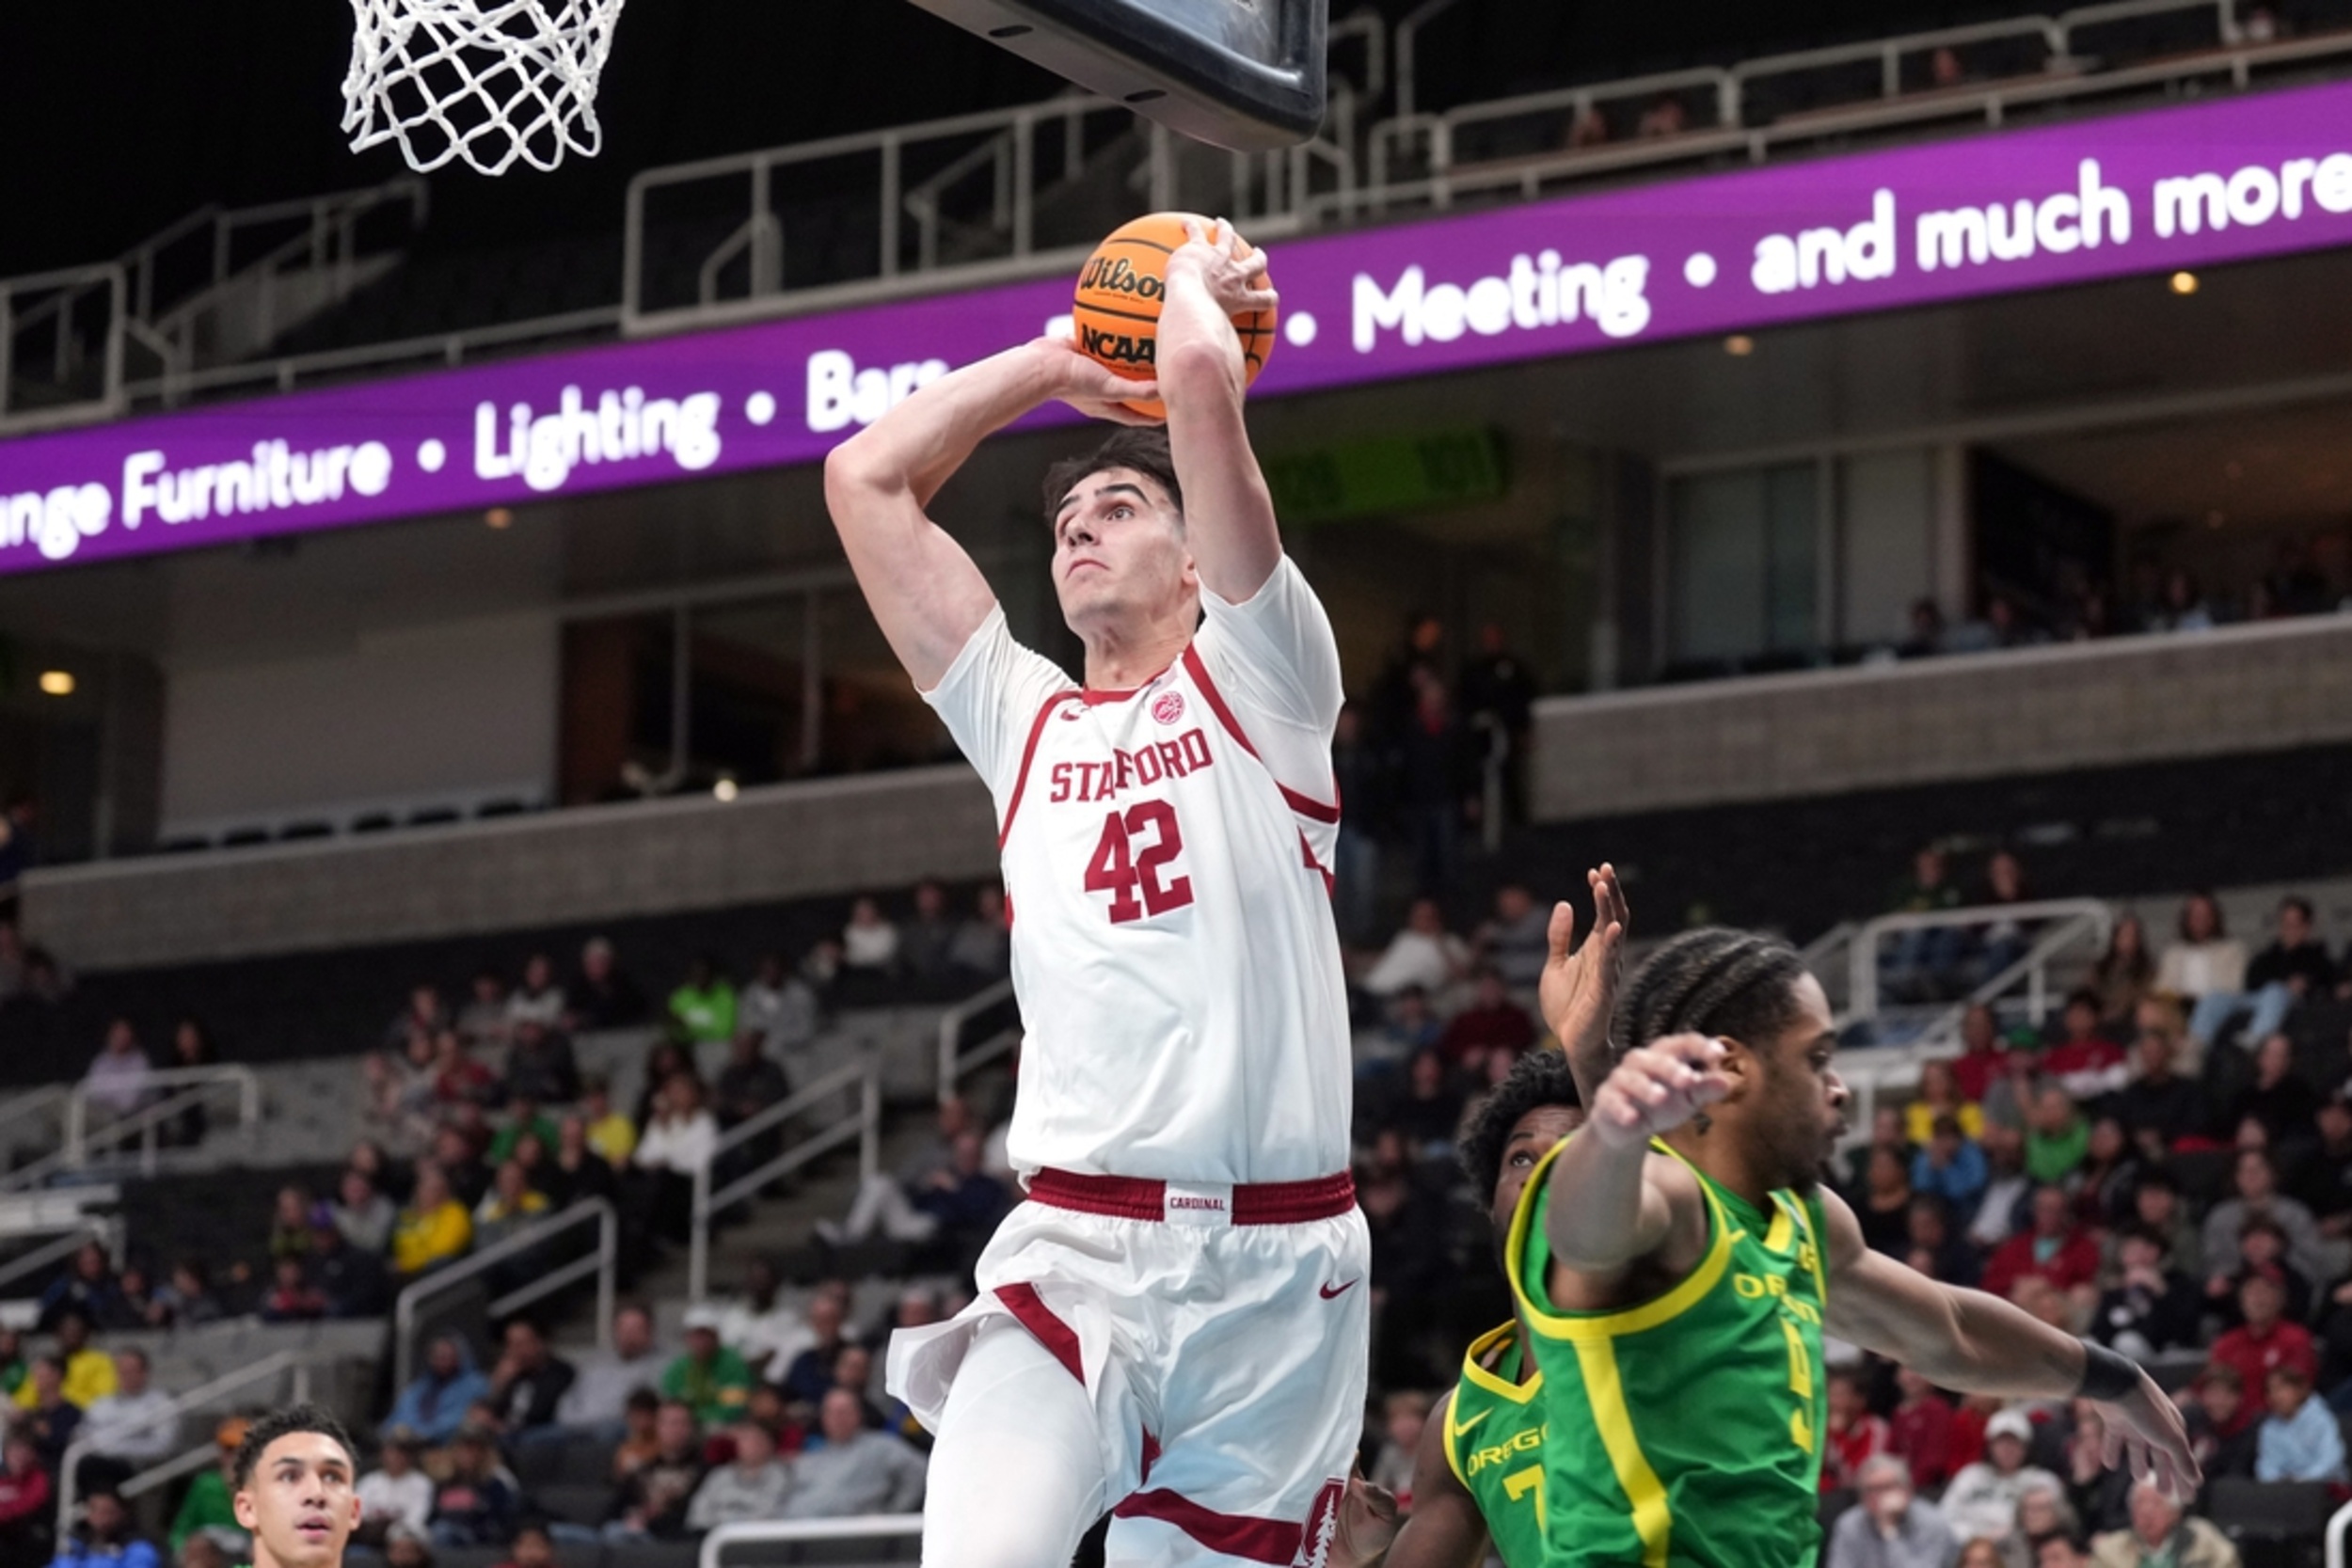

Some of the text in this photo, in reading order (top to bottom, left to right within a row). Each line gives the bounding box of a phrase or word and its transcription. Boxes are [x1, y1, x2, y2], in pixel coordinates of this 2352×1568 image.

[122, 439, 392, 529] Furniture
[475, 386, 721, 491] Lighting
[806, 349, 950, 433] Bar
[1352, 250, 1650, 354] Meeting
[1752, 188, 1897, 294] and
[1916, 158, 2131, 271] much
[2153, 152, 2352, 238] more
[1082, 324, 1156, 365] NCAA
[1085, 799, 1194, 925] 42
[1169, 1196, 1225, 1212] CARDINAL
[1502, 1463, 1547, 1537] 7
